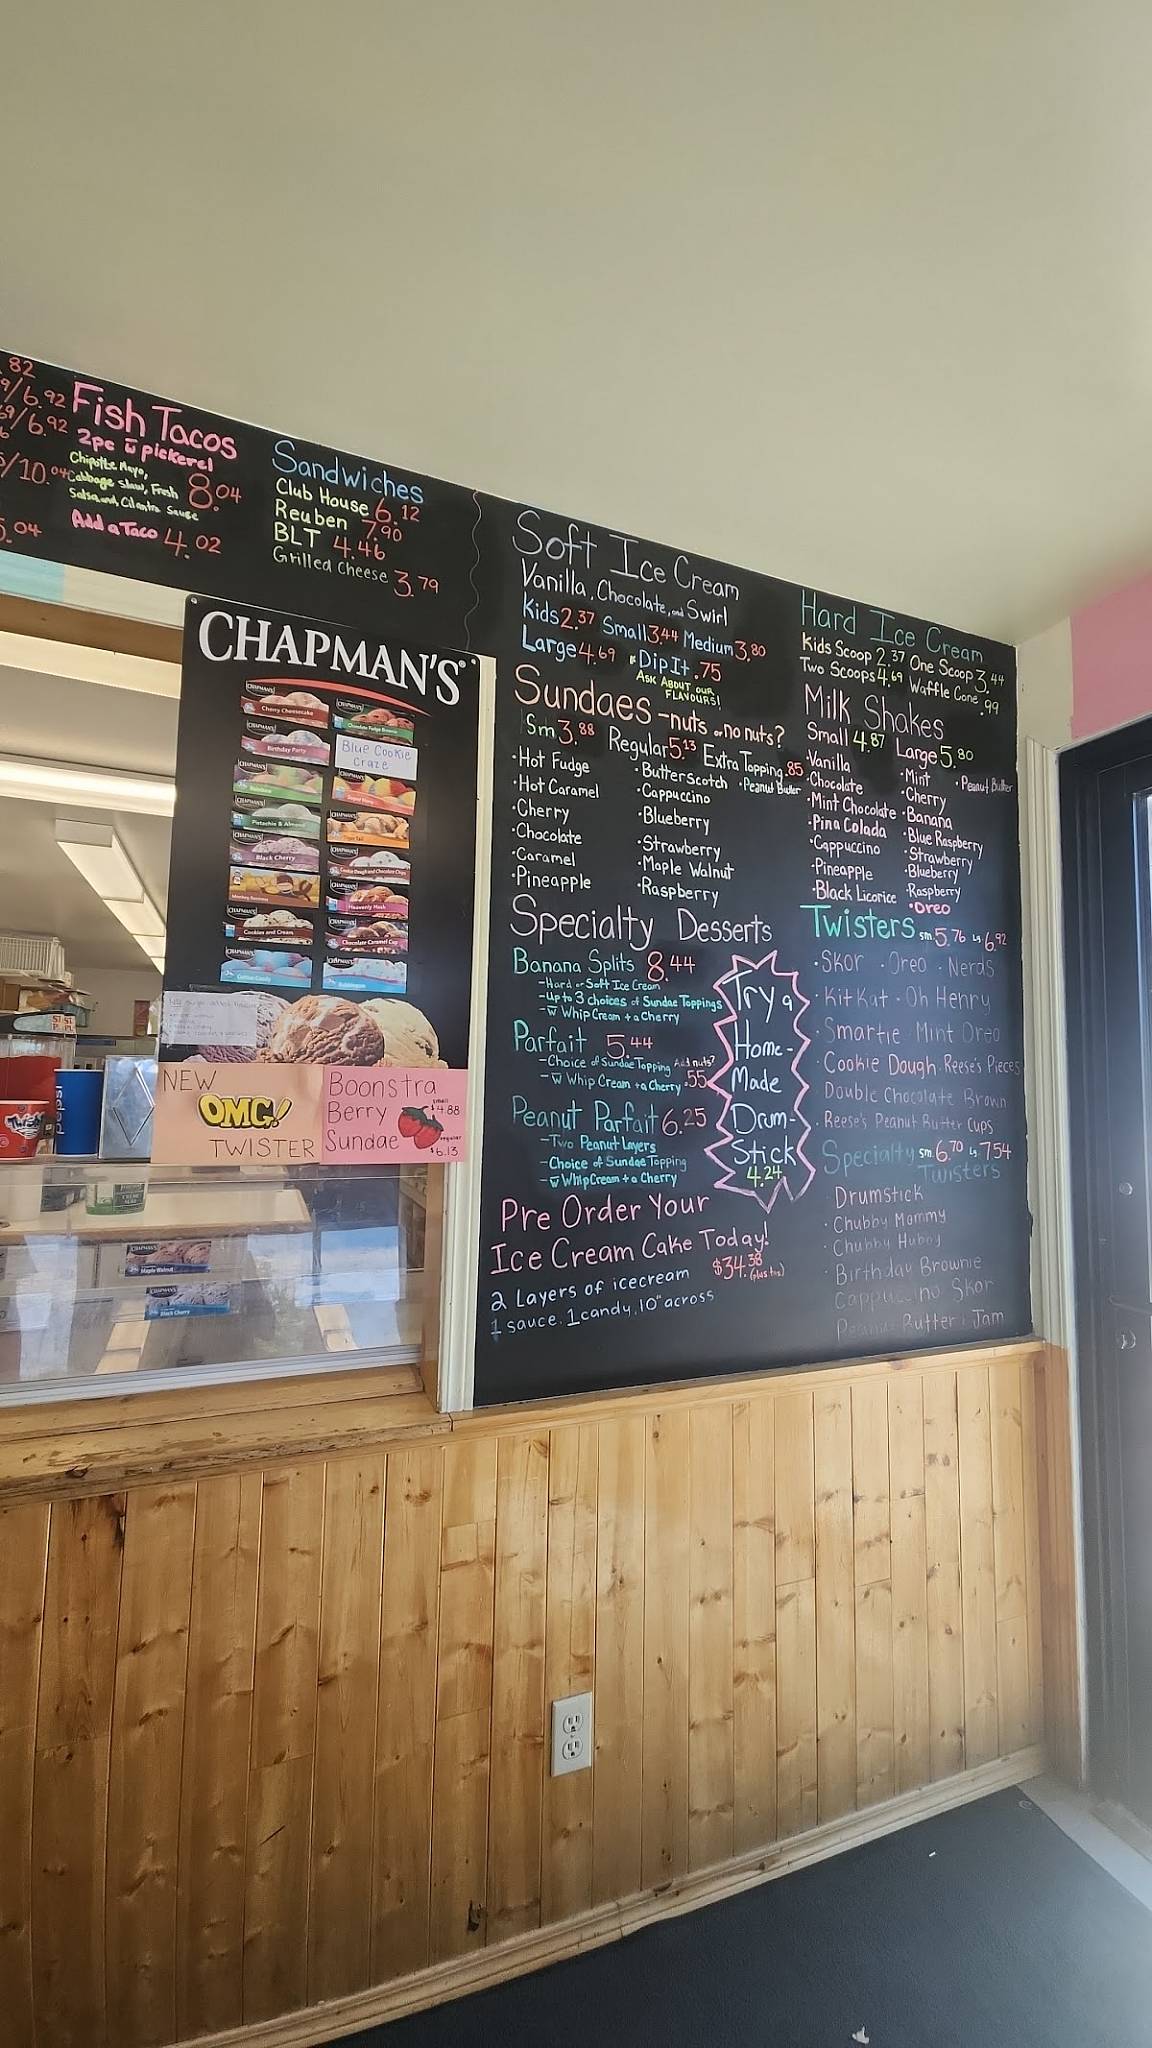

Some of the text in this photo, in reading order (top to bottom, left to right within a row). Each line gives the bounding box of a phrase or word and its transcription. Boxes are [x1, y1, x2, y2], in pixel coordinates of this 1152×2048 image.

[72, 381, 238, 460] Fish Tacos
[141, 443, 214, 472] pickerel
[272, 439, 424, 504] Sandwiches
[275, 477, 420, 526] Club House 6.12
[71, 509, 221, 559] Add Taco 4.02
[275, 498, 403, 543] Reuben 7.90
[273, 522, 386, 561] BLT 4.46
[512, 510, 740, 600] Soft Ice Cream
[273, 545, 440, 598] Grilled Cheese 3.79
[522, 592, 767, 663] Kids 2.37 Small 3.44 Medium 3.80
[686, 599, 728, 627] Swirl
[801, 589, 984, 663] Hard Ice Cream
[198, 610, 461, 706] CHAPMAN'S
[521, 624, 722, 682] Large 4.69 .75
[802, 632, 1005, 695] Kids Scoop 2.37 One Scoop 3.44
[800, 656, 1000, 716] Two Scoops 4.69 Waffle Cone .99
[513, 663, 785, 748] Sundaes no nuts?
[804, 683, 945, 741] Milk Shakes
[525, 712, 784, 783] Sm 3.88 Regular 5.13 Extra Topping
[806, 721, 974, 770] Small 4.87 Large 5.80
[551, 751, 591, 778] Fudge
[807, 749, 851, 773] Vanilla
[548, 777, 600, 800] Caramel
[808, 771, 864, 796] Chocolate
[905, 768, 931, 788] Mint
[641, 782, 712, 806] Cappuccino
[516, 798, 570, 825] Cherry
[642, 807, 710, 836] Blueberry
[906, 807, 953, 830] Banana
[516, 823, 583, 846] Chocolate
[641, 835, 722, 862] Strawberry
[813, 834, 881, 859] Cappuccino
[516, 865, 592, 893] Pineapple
[642, 855, 736, 881] Maple Walnut
[814, 857, 874, 881] Pineapple
[815, 880, 898, 904] Black Licorice
[510, 893, 773, 951] Specialty Desserts
[800, 904, 916, 940] Twisters
[513, 947, 697, 982] Banana Splits 8.44
[821, 949, 996, 978] Skor Nerds
[679, 994, 724, 1011] Toppings
[721, 969, 776, 1023] Try
[936, 986, 992, 1016] Henry
[641, 1010, 681, 1026] Cherry
[513, 1019, 654, 1060] Parfait 5.44
[731, 1066, 783, 1094] Made
[823, 1051, 937, 1080] Cookie Dough
[163, 1069, 217, 1092] NEW
[328, 1070, 437, 1099] Boonstra
[198, 1094, 293, 1130] OMG!
[327, 1100, 387, 1126] Berry
[512, 1095, 708, 1137] Peanut Parfait 6.25
[209, 1137, 316, 1160] TWISTER
[325, 1128, 400, 1153] Sundae
[580, 1135, 657, 1154] Peanut Layers
[730, 1135, 798, 1167] Stick
[822, 1138, 916, 1176] Specialty
[746, 1165, 784, 1188] 4.24
[835, 1183, 925, 1210] Drumstick
[501, 1192, 711, 1233] Pre Order Your
[490, 1220, 771, 1276] Ice Cream Cake Today!
[516, 1267, 691, 1310] Layers icecream
[664, 1289, 716, 1309] across
[971, 1308, 1006, 1330] Jam
